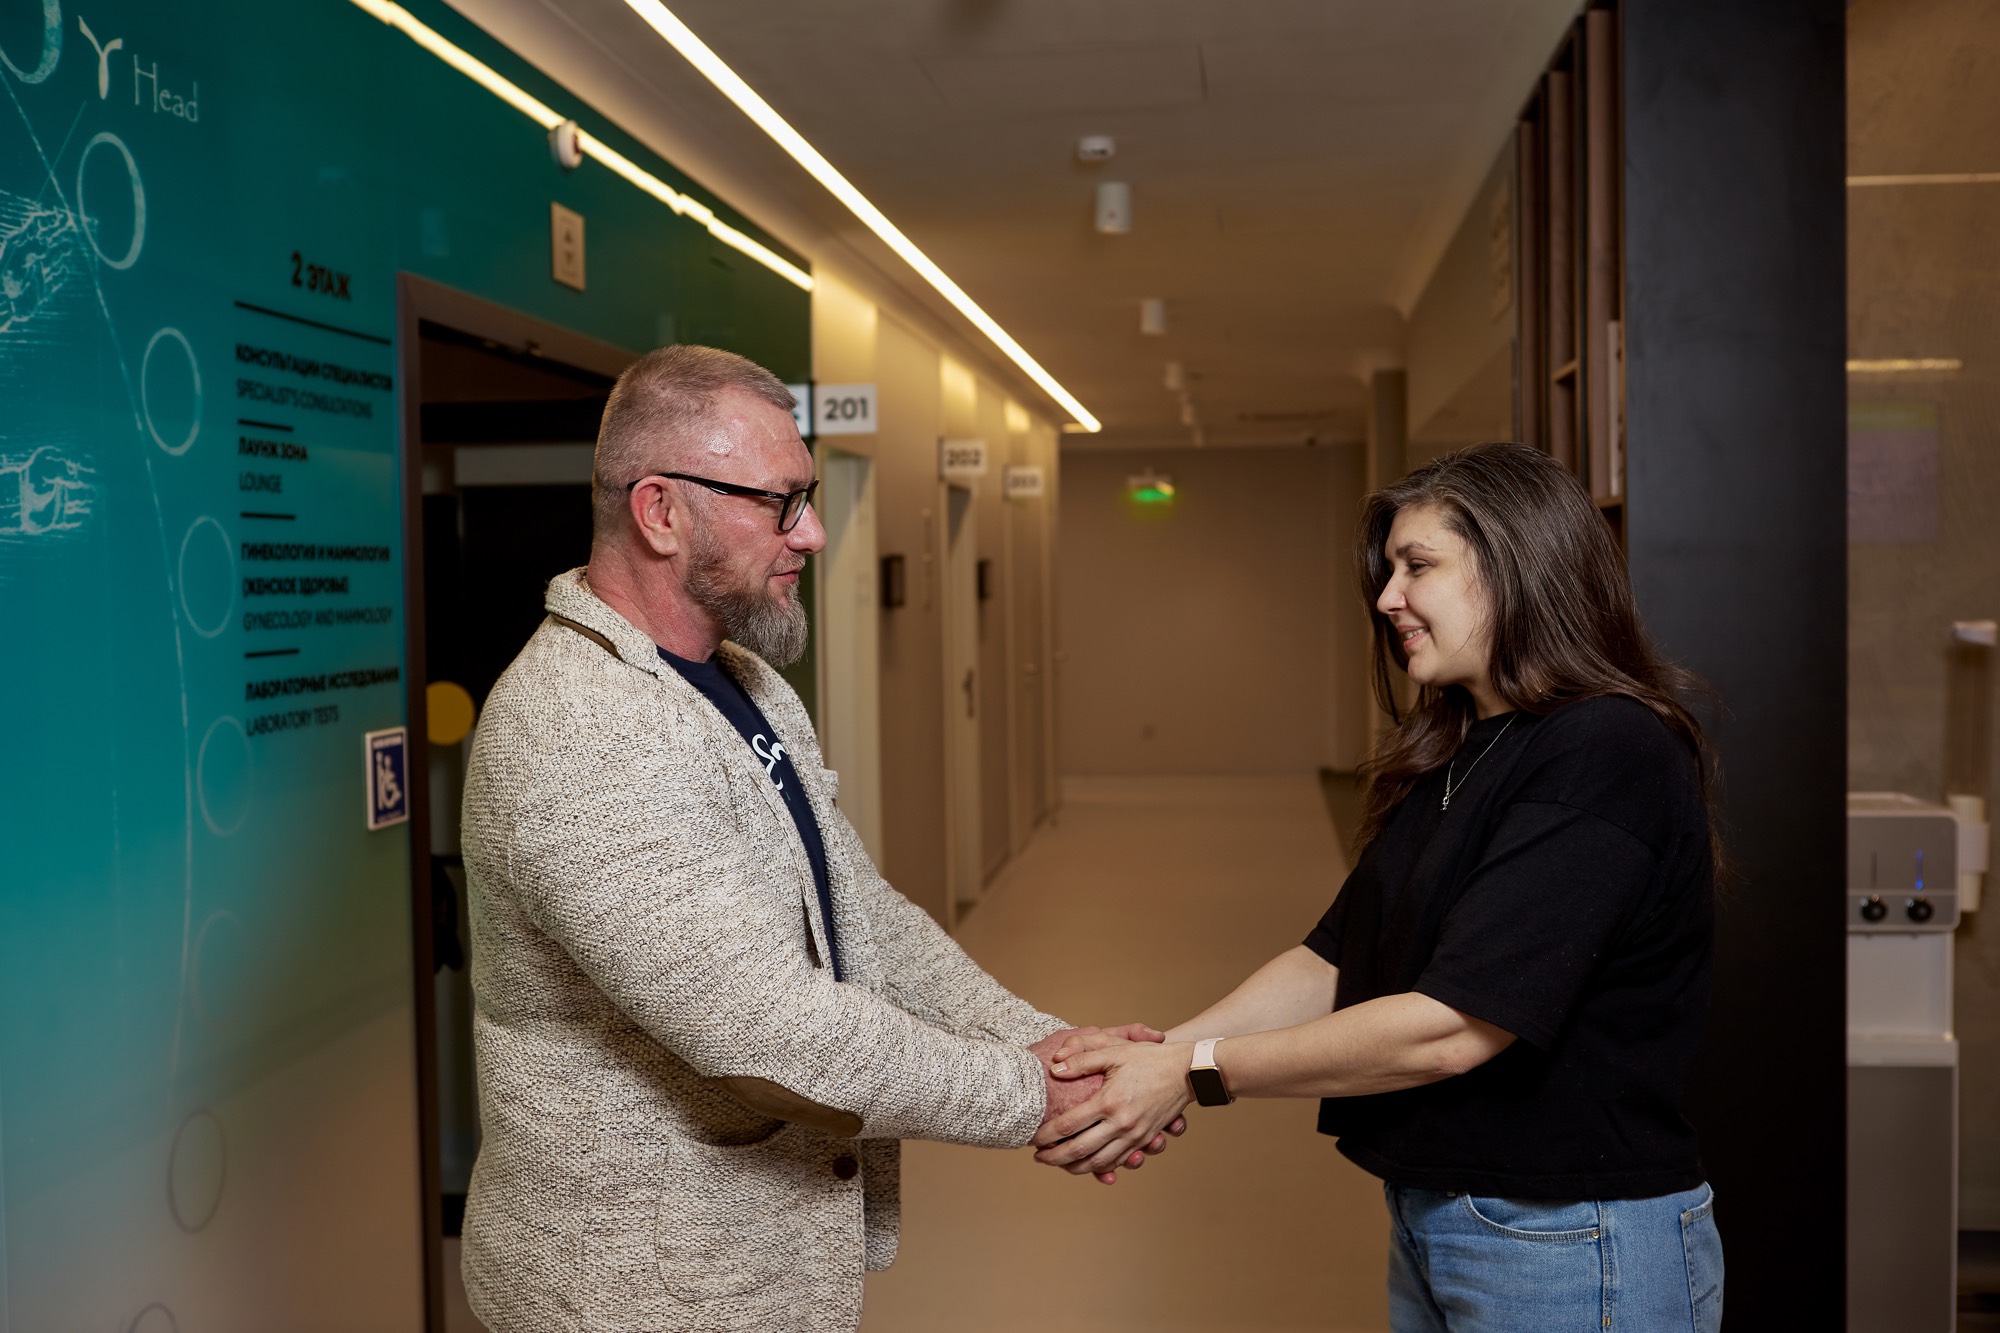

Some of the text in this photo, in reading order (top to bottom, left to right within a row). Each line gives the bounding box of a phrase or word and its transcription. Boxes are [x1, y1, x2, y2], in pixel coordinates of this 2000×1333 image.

[134, 54, 199, 123] Head
[292, 252, 351, 300] 2 ЭТАЖ
[236, 344, 319, 376] КОНСУЛЬТАЦИИ
[824, 397, 868, 420] 201
[238, 436, 308, 461] ЛАУНЖ ЗОНА
[239, 472, 282, 493] LOUNGE
[241, 543, 390, 562] ГИНЕКОЛОГИЯ И МАММОЛОГИЯ
[243, 606, 392, 632] GYNECOLOGY AND MAMMOLOGY
[245, 667, 399, 702] ЛАБОРАТОРНЫЕ ИССЛЕДОВАНИЯ
[246, 705, 339, 737] LABORATORY TESTS
